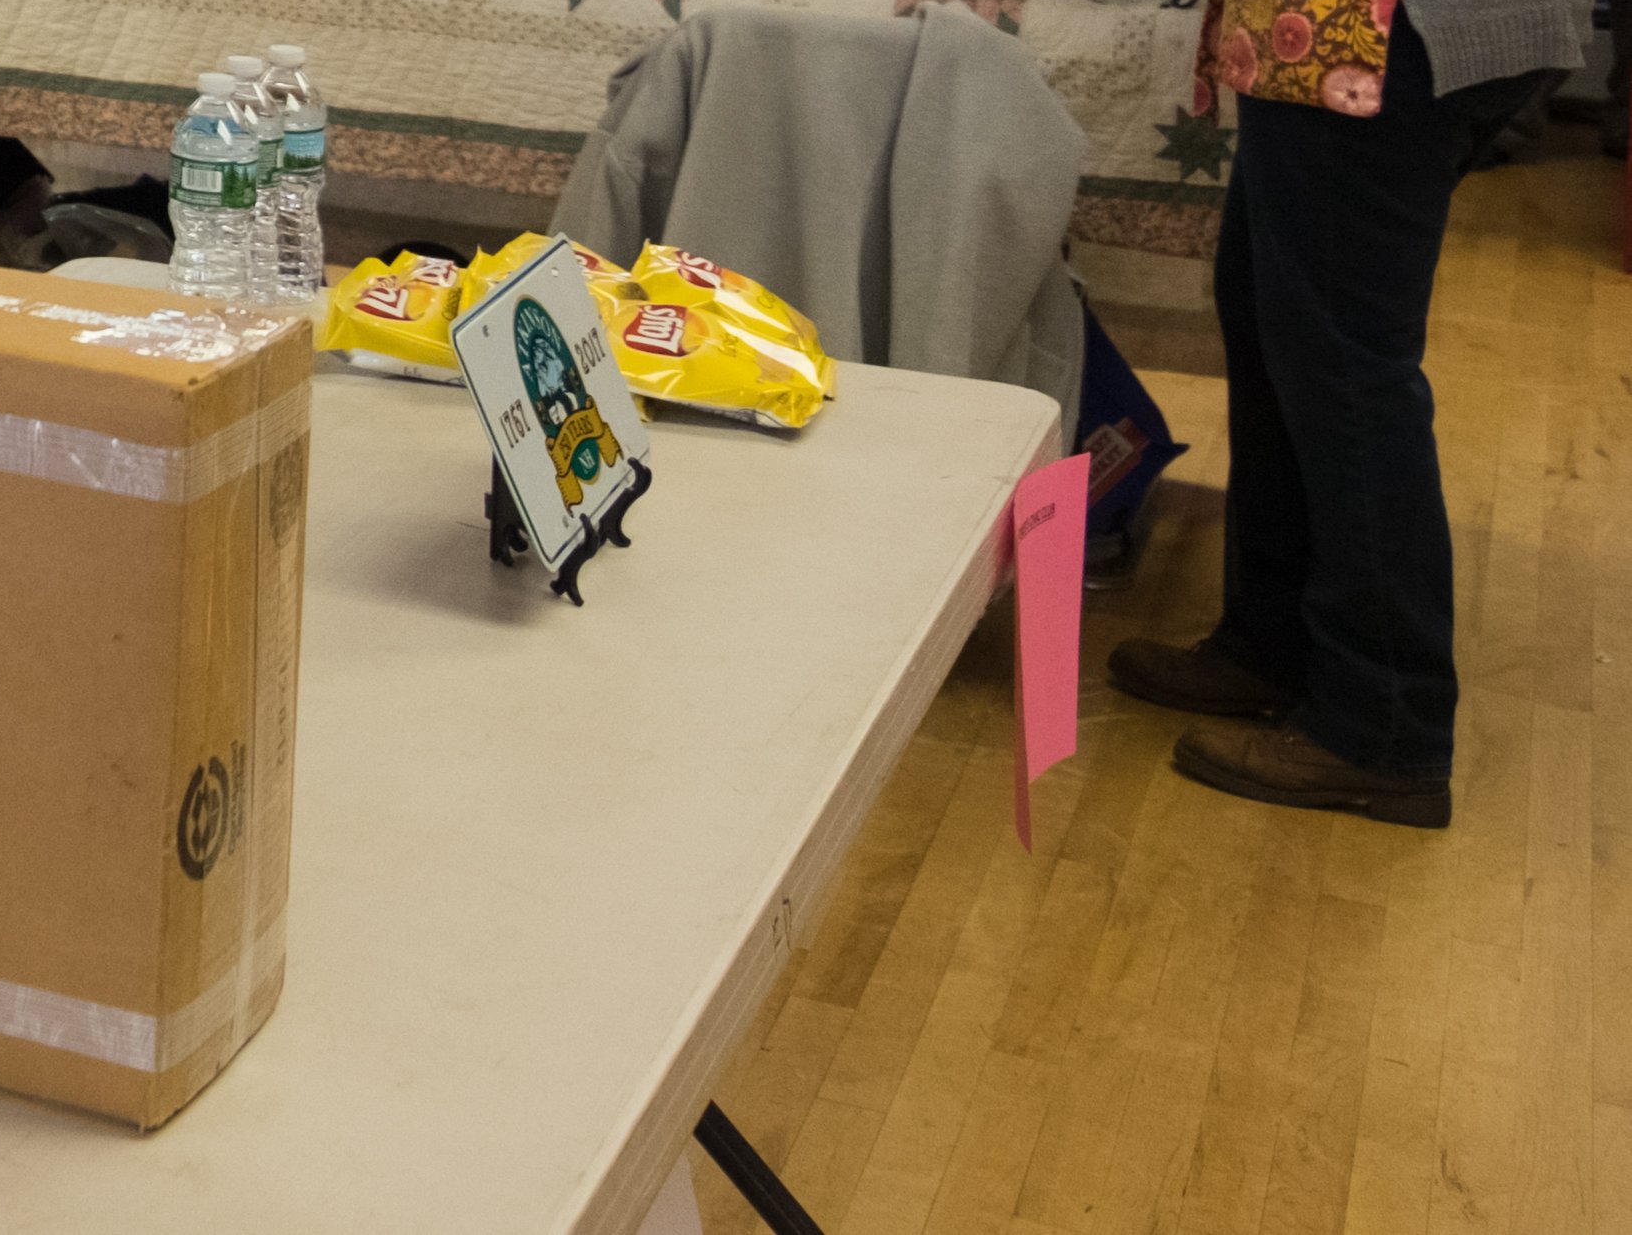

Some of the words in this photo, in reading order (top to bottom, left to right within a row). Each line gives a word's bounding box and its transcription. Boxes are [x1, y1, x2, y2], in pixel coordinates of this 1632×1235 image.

[518, 306, 562, 381] ATKINSON
[574, 327, 606, 375] 2017
[625, 305, 685, 353] Lay's
[499, 399, 531, 449] 1767
[566, 414, 595, 442] YEARS
[578, 448, 595, 474] NH
